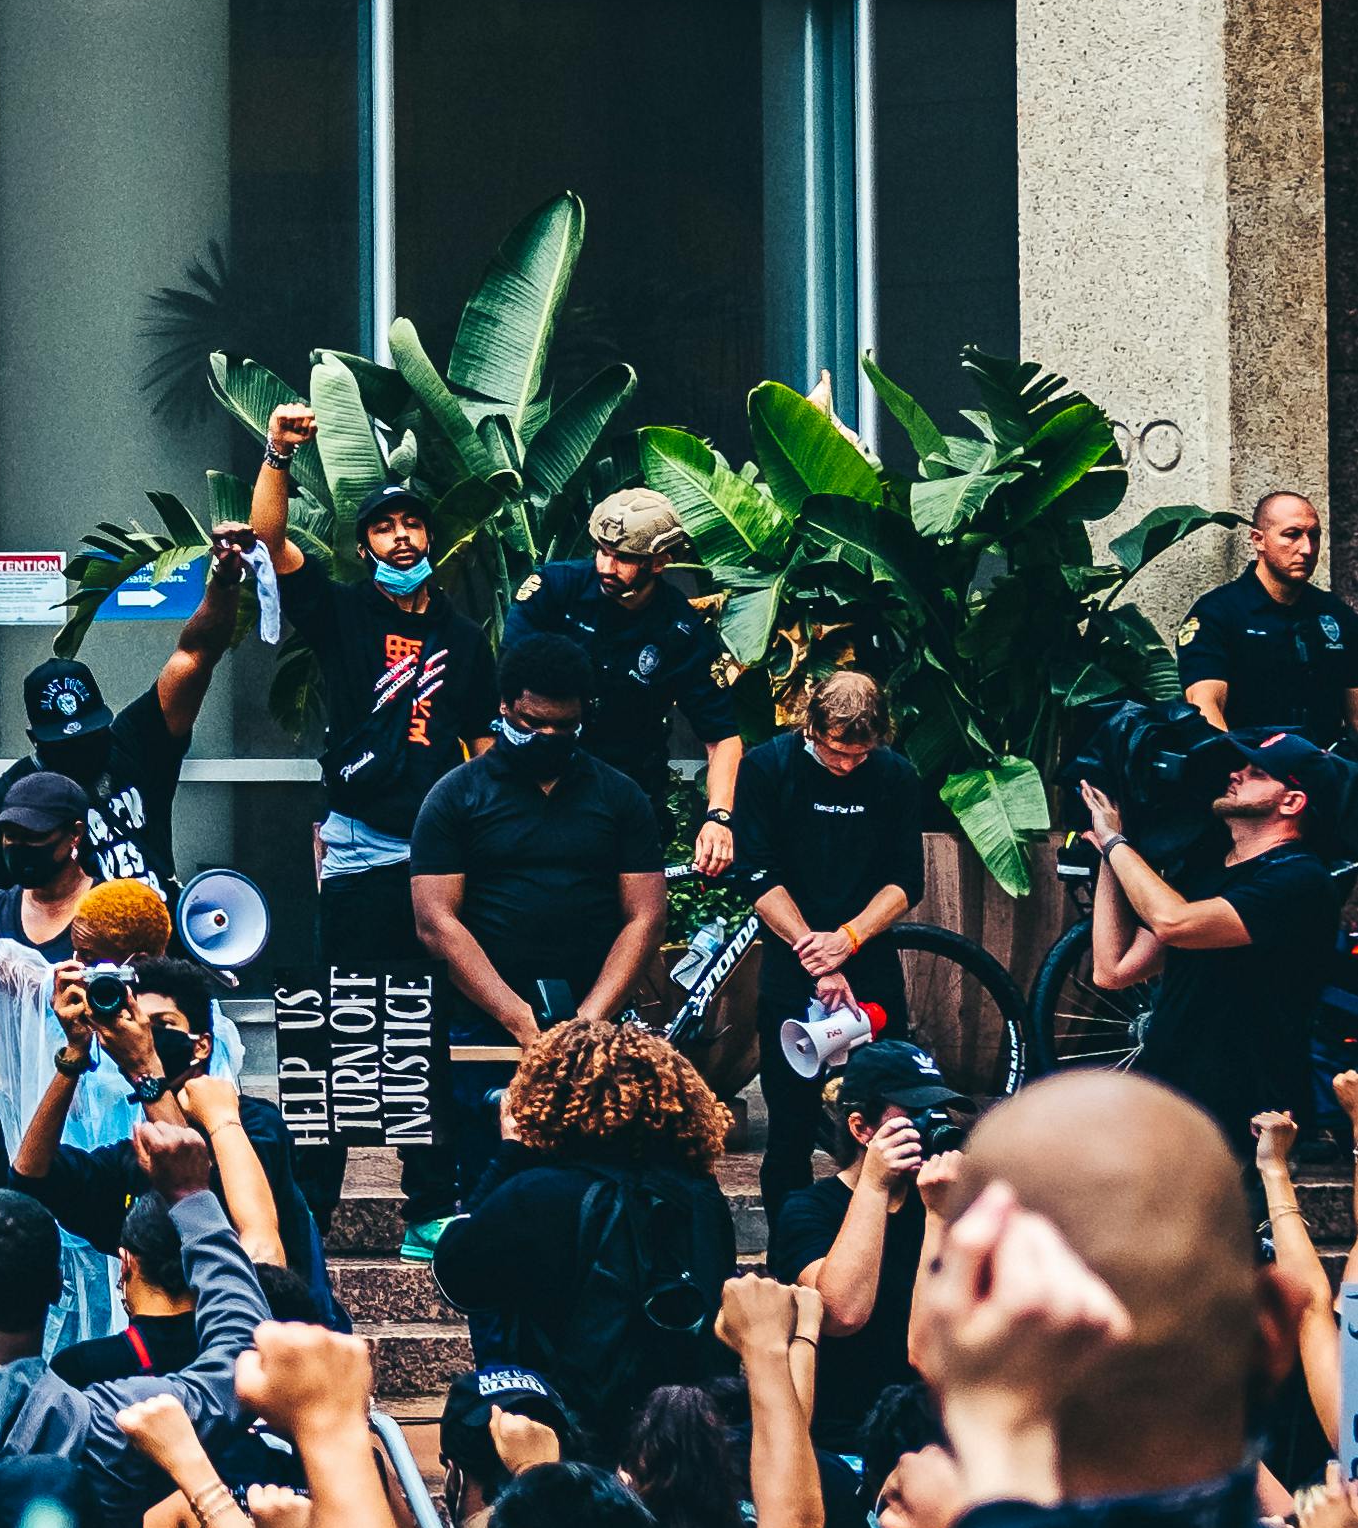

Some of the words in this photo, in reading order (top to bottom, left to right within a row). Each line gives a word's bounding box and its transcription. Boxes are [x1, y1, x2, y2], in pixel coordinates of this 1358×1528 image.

[275, 987, 325, 1030] US
[330, 966, 377, 1033] OFF
[278, 1057, 329, 1145] HELP
[331, 1043, 383, 1132] TURN
[381, 974, 433, 1145] INJUSTICE
